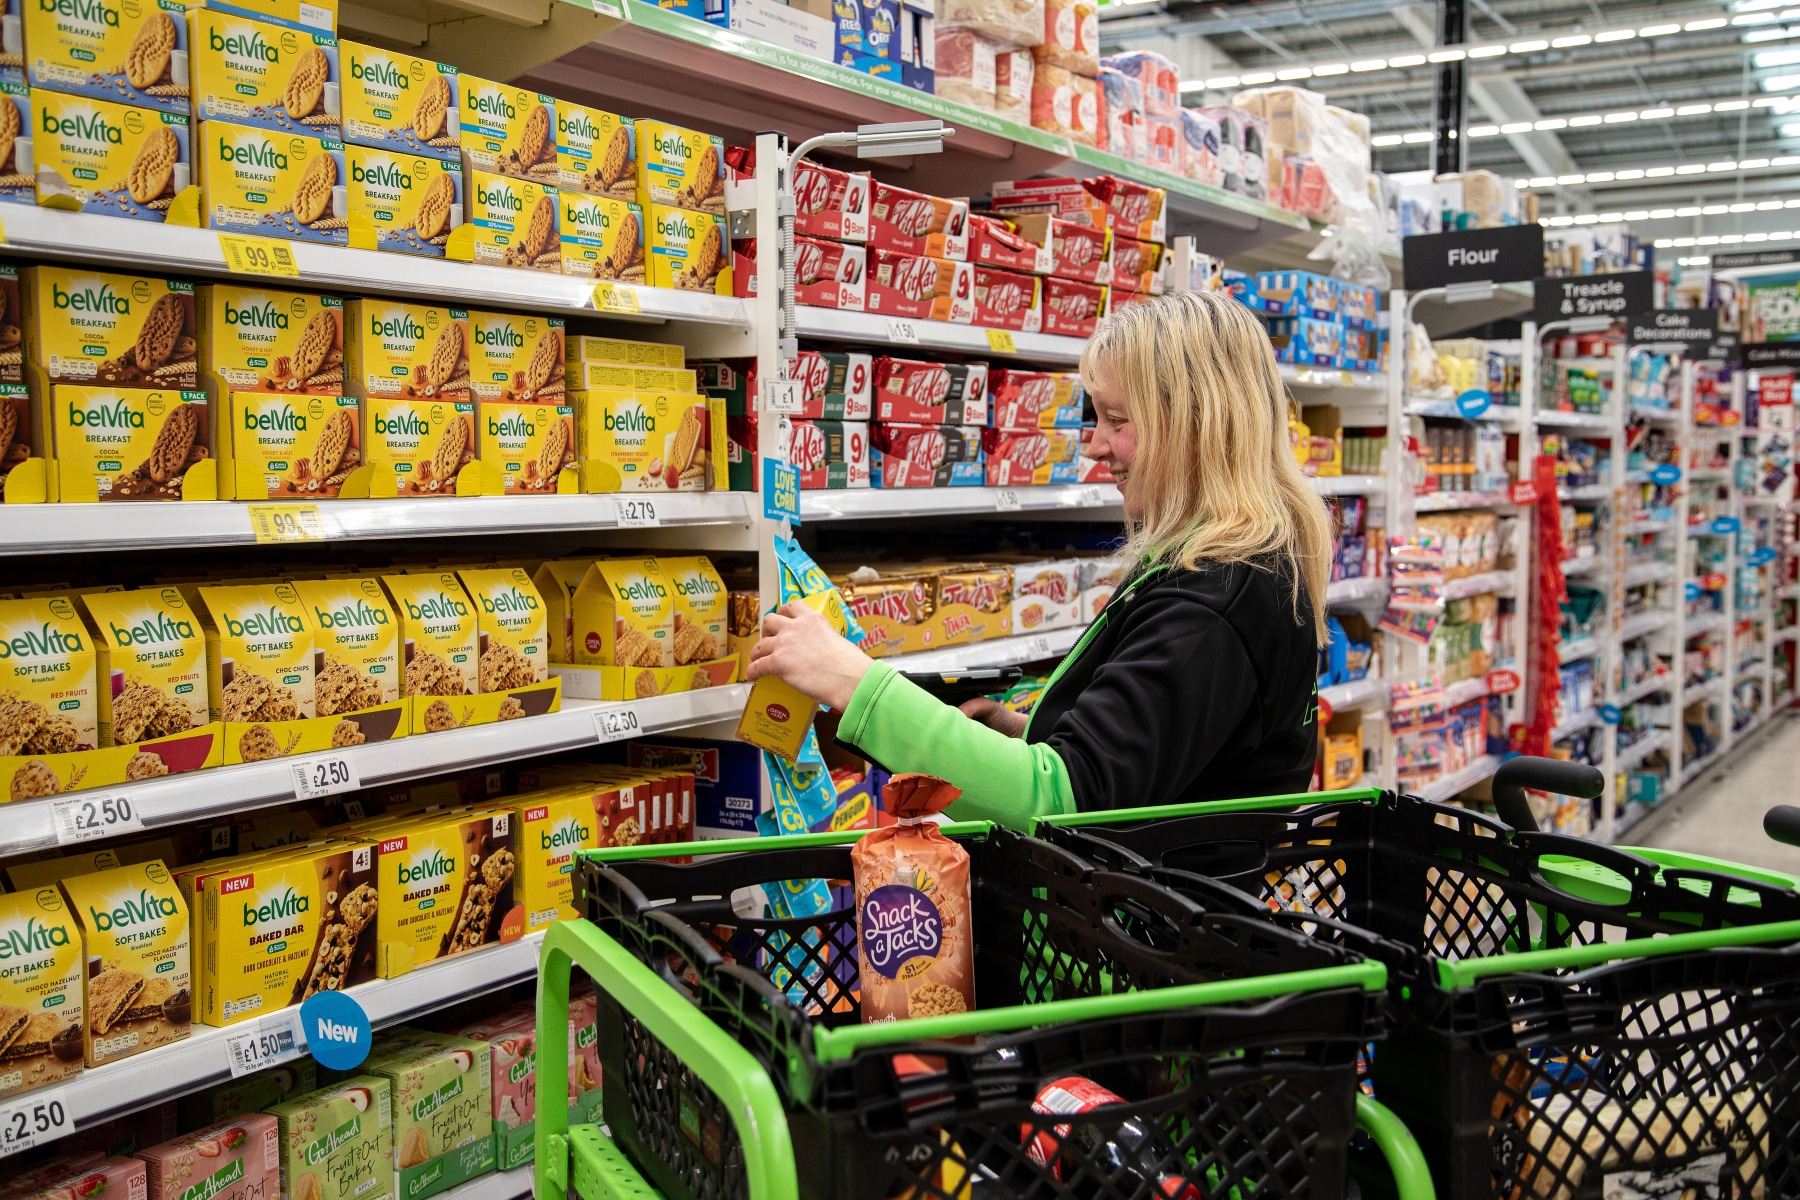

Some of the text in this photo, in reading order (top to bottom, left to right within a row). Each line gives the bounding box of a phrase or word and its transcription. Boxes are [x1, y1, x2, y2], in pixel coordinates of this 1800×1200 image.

[57, 24, 106, 40] BREAKFAST
[321, 36, 336, 46] PACK
[210, 26, 279, 64] belVita
[225, 61, 267, 75] BREAKFAST
[351, 56, 409, 90] belVita
[800, 60, 837, 80] additional
[861, 79, 873, 89] For
[468, 89, 515, 120] belVita
[42, 107, 122, 145] belVita
[559, 113, 599, 141] belVita
[60, 144, 108, 157] BREAKFAST
[220, 137, 288, 170] belVita
[654, 133, 692, 160] belVita
[235, 170, 276, 182] BREAKFAST
[352, 157, 412, 190] belVita
[478, 183, 522, 212] belVita
[568, 201, 609, 229] belVita
[658, 218, 695, 240] belVita
[852, 224, 865, 234] Bars
[953, 245, 964, 254] Bars
[1448, 248, 1498, 267] Flour
[177, 283, 192, 291] PACK
[957, 270, 968, 298] 9
[1562, 281, 1623, 297] Treacle
[53, 283, 130, 315] belVita
[1577, 297, 1625, 313] Syrup
[70, 318, 116, 328] BREAKFAST
[225, 301, 289, 330] belVita
[238, 333, 277, 342] BREAKFAST
[372, 313, 425, 341] belVita
[475, 323, 523, 348] belVita
[721, 369, 728, 380] 9
[69, 399, 144, 429] belVita
[245, 403, 307, 431] belVita
[604, 405, 655, 432] belVita
[854, 403, 867, 413] Bars
[375, 409, 429, 435] belVita
[489, 414, 535, 437] belVita
[86, 435, 131, 443] BREAKFAST
[625, 503, 655, 520] £2.79
[615, 576, 667, 601] belVita
[673, 573, 722, 597] belVita
[404, 592, 468, 621] belVita
[479, 587, 539, 615] belVita
[223, 606, 304, 638] belVita
[315, 599, 389, 629] belVita
[498, 617, 531, 627] SOFT BAKES
[110, 611, 194, 647] belVita
[336, 633, 378, 643] SOFT BAKES
[424, 624, 461, 634] SOFT BAKES
[136, 649, 184, 662] SOFT BAKES
[246, 641, 293, 652] SOFT BAKES
[14, 663, 71, 676] SOFT BAKES
[66, 689, 88, 697] FRUITS
[607, 711, 638, 733] £2.50
[313, 760, 349, 787] £2.50
[622, 793, 628, 804] 4
[728, 798, 750, 808] 30273
[77, 796, 132, 830] £2.50
[528, 809, 545, 821] NEW
[495, 819, 502, 832] 4
[542, 818, 589, 850] belVita
[383, 840, 403, 852] NEW
[356, 853, 363, 866] 4
[398, 849, 455, 885] belVita
[546, 855, 571, 866] BAKED
[226, 878, 249, 891] NEW
[403, 884, 450, 902] BAKED BAR
[90, 888, 178, 932] belVita
[244, 886, 309, 927] belVita
[865, 894, 930, 940] Snack
[0, 917, 70, 959] elVita
[115, 927, 166, 946] SOFT BAKES
[249, 924, 304, 945] BAKED BAR
[504, 925, 521, 935] NEW
[871, 918, 937, 965] a Jacks
[141, 950, 161, 959] CHOCO
[153, 950, 177, 961] FLAVOUR
[30, 958, 55, 974] BAKES
[172, 972, 188, 982] FILLED
[905, 965, 916, 974] 51
[318, 1018, 358, 1043] New
[245, 1034, 278, 1062] £1.50
[5, 1101, 65, 1143] £2.50
